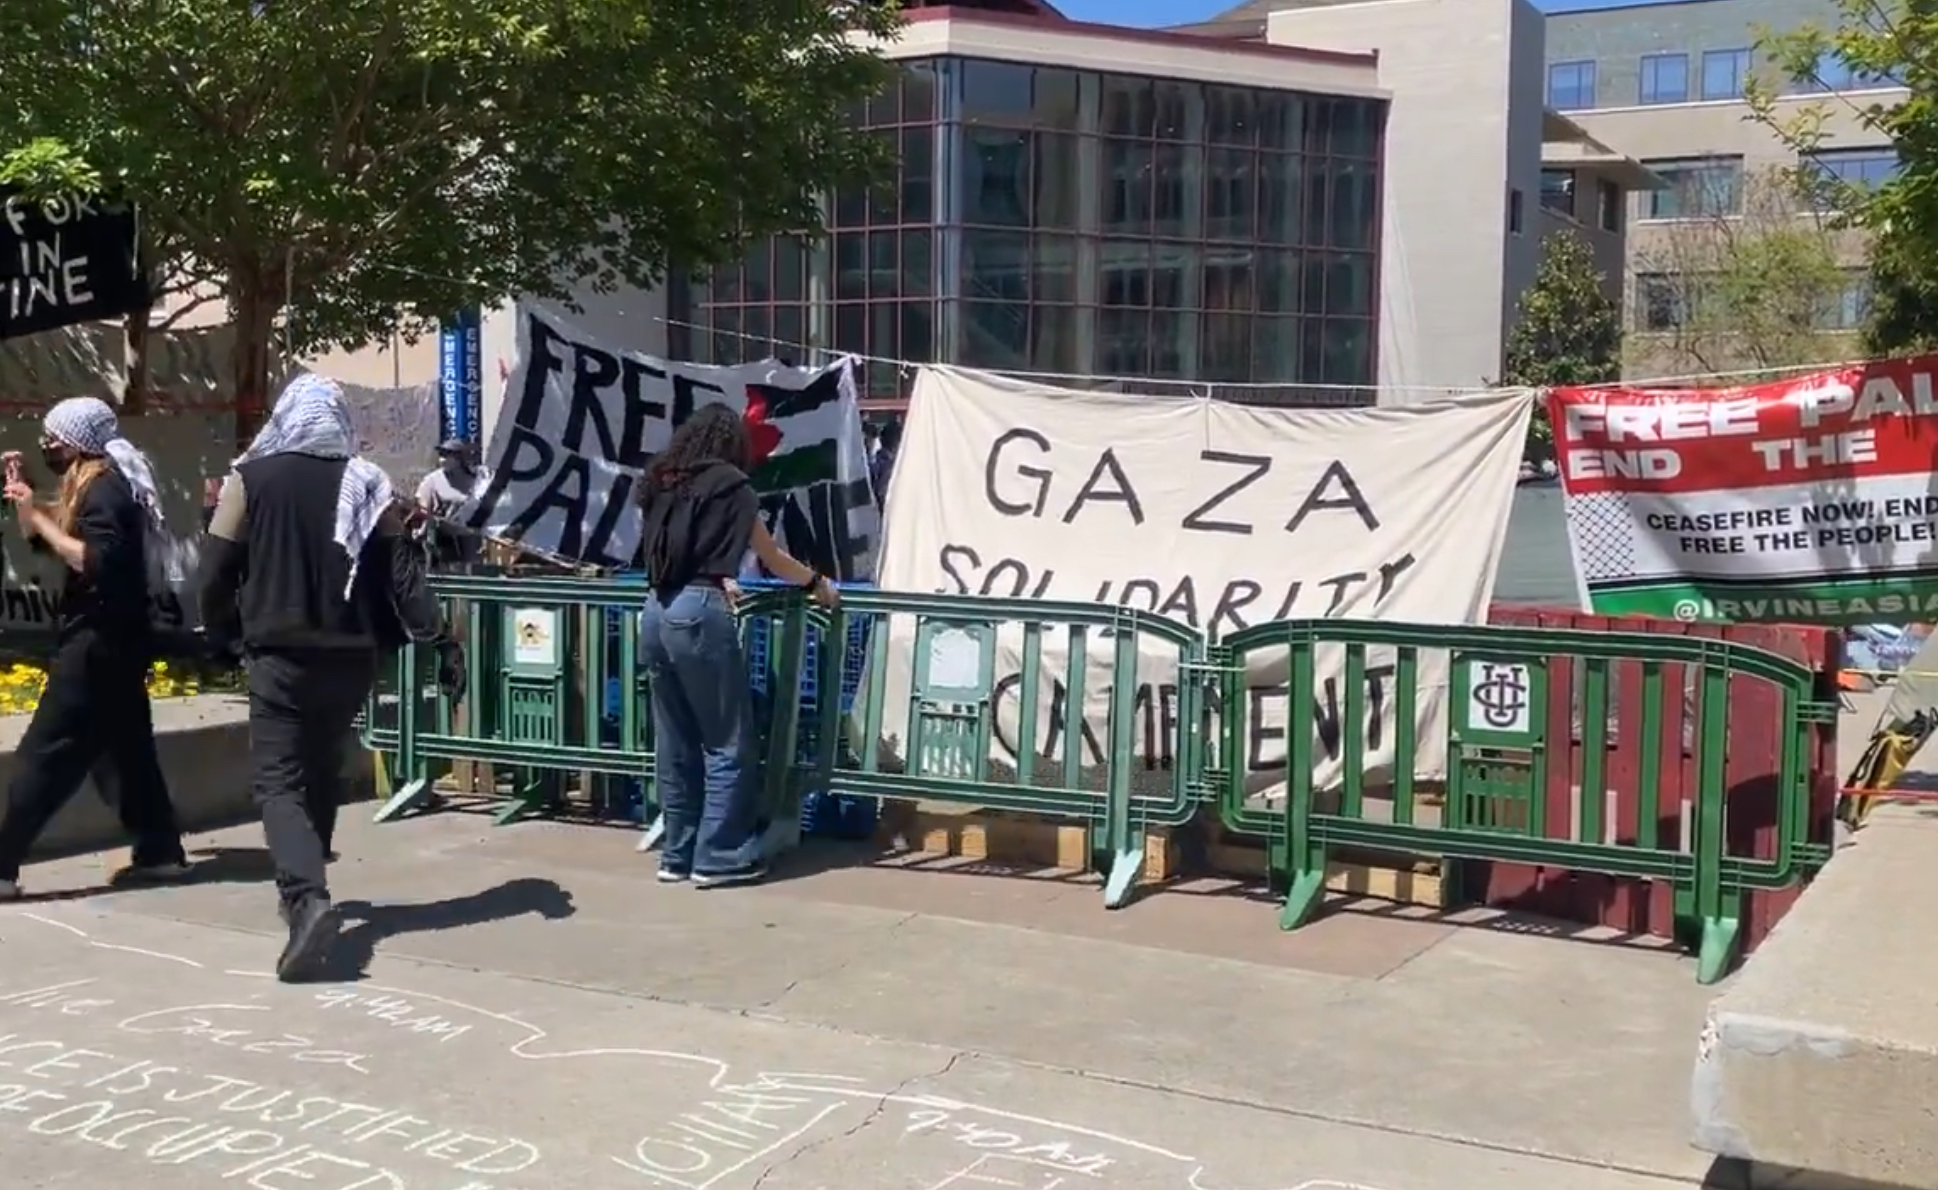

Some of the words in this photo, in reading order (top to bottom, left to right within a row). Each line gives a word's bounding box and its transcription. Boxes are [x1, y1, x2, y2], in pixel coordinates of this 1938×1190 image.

[20, 231, 60, 276] IN
[0, 256, 94, 319] INE
[444, 328, 457, 441] MERGENC
[466, 327, 478, 446] EMERGENCY
[1564, 396, 1758, 443] FREE
[986, 427, 1380, 534] GAZA
[1568, 449, 1682, 481] END
[1752, 429, 1878, 469] THE
[467, 426, 875, 581] PALNE
[1647, 507, 1792, 532] CEASEFIRE
[1802, 500, 1874, 523] NOW!
[1885, 496, 1938, 517] END
[1681, 536, 1745, 555] FREE
[1757, 530, 1809, 552] THE
[1818, 522, 1935, 547] PEOPLE!
[0, 1034, 114, 1079] CE
[84, 1060, 178, 1095] IS
[164, 1074, 540, 1174] JUSTIFIED
